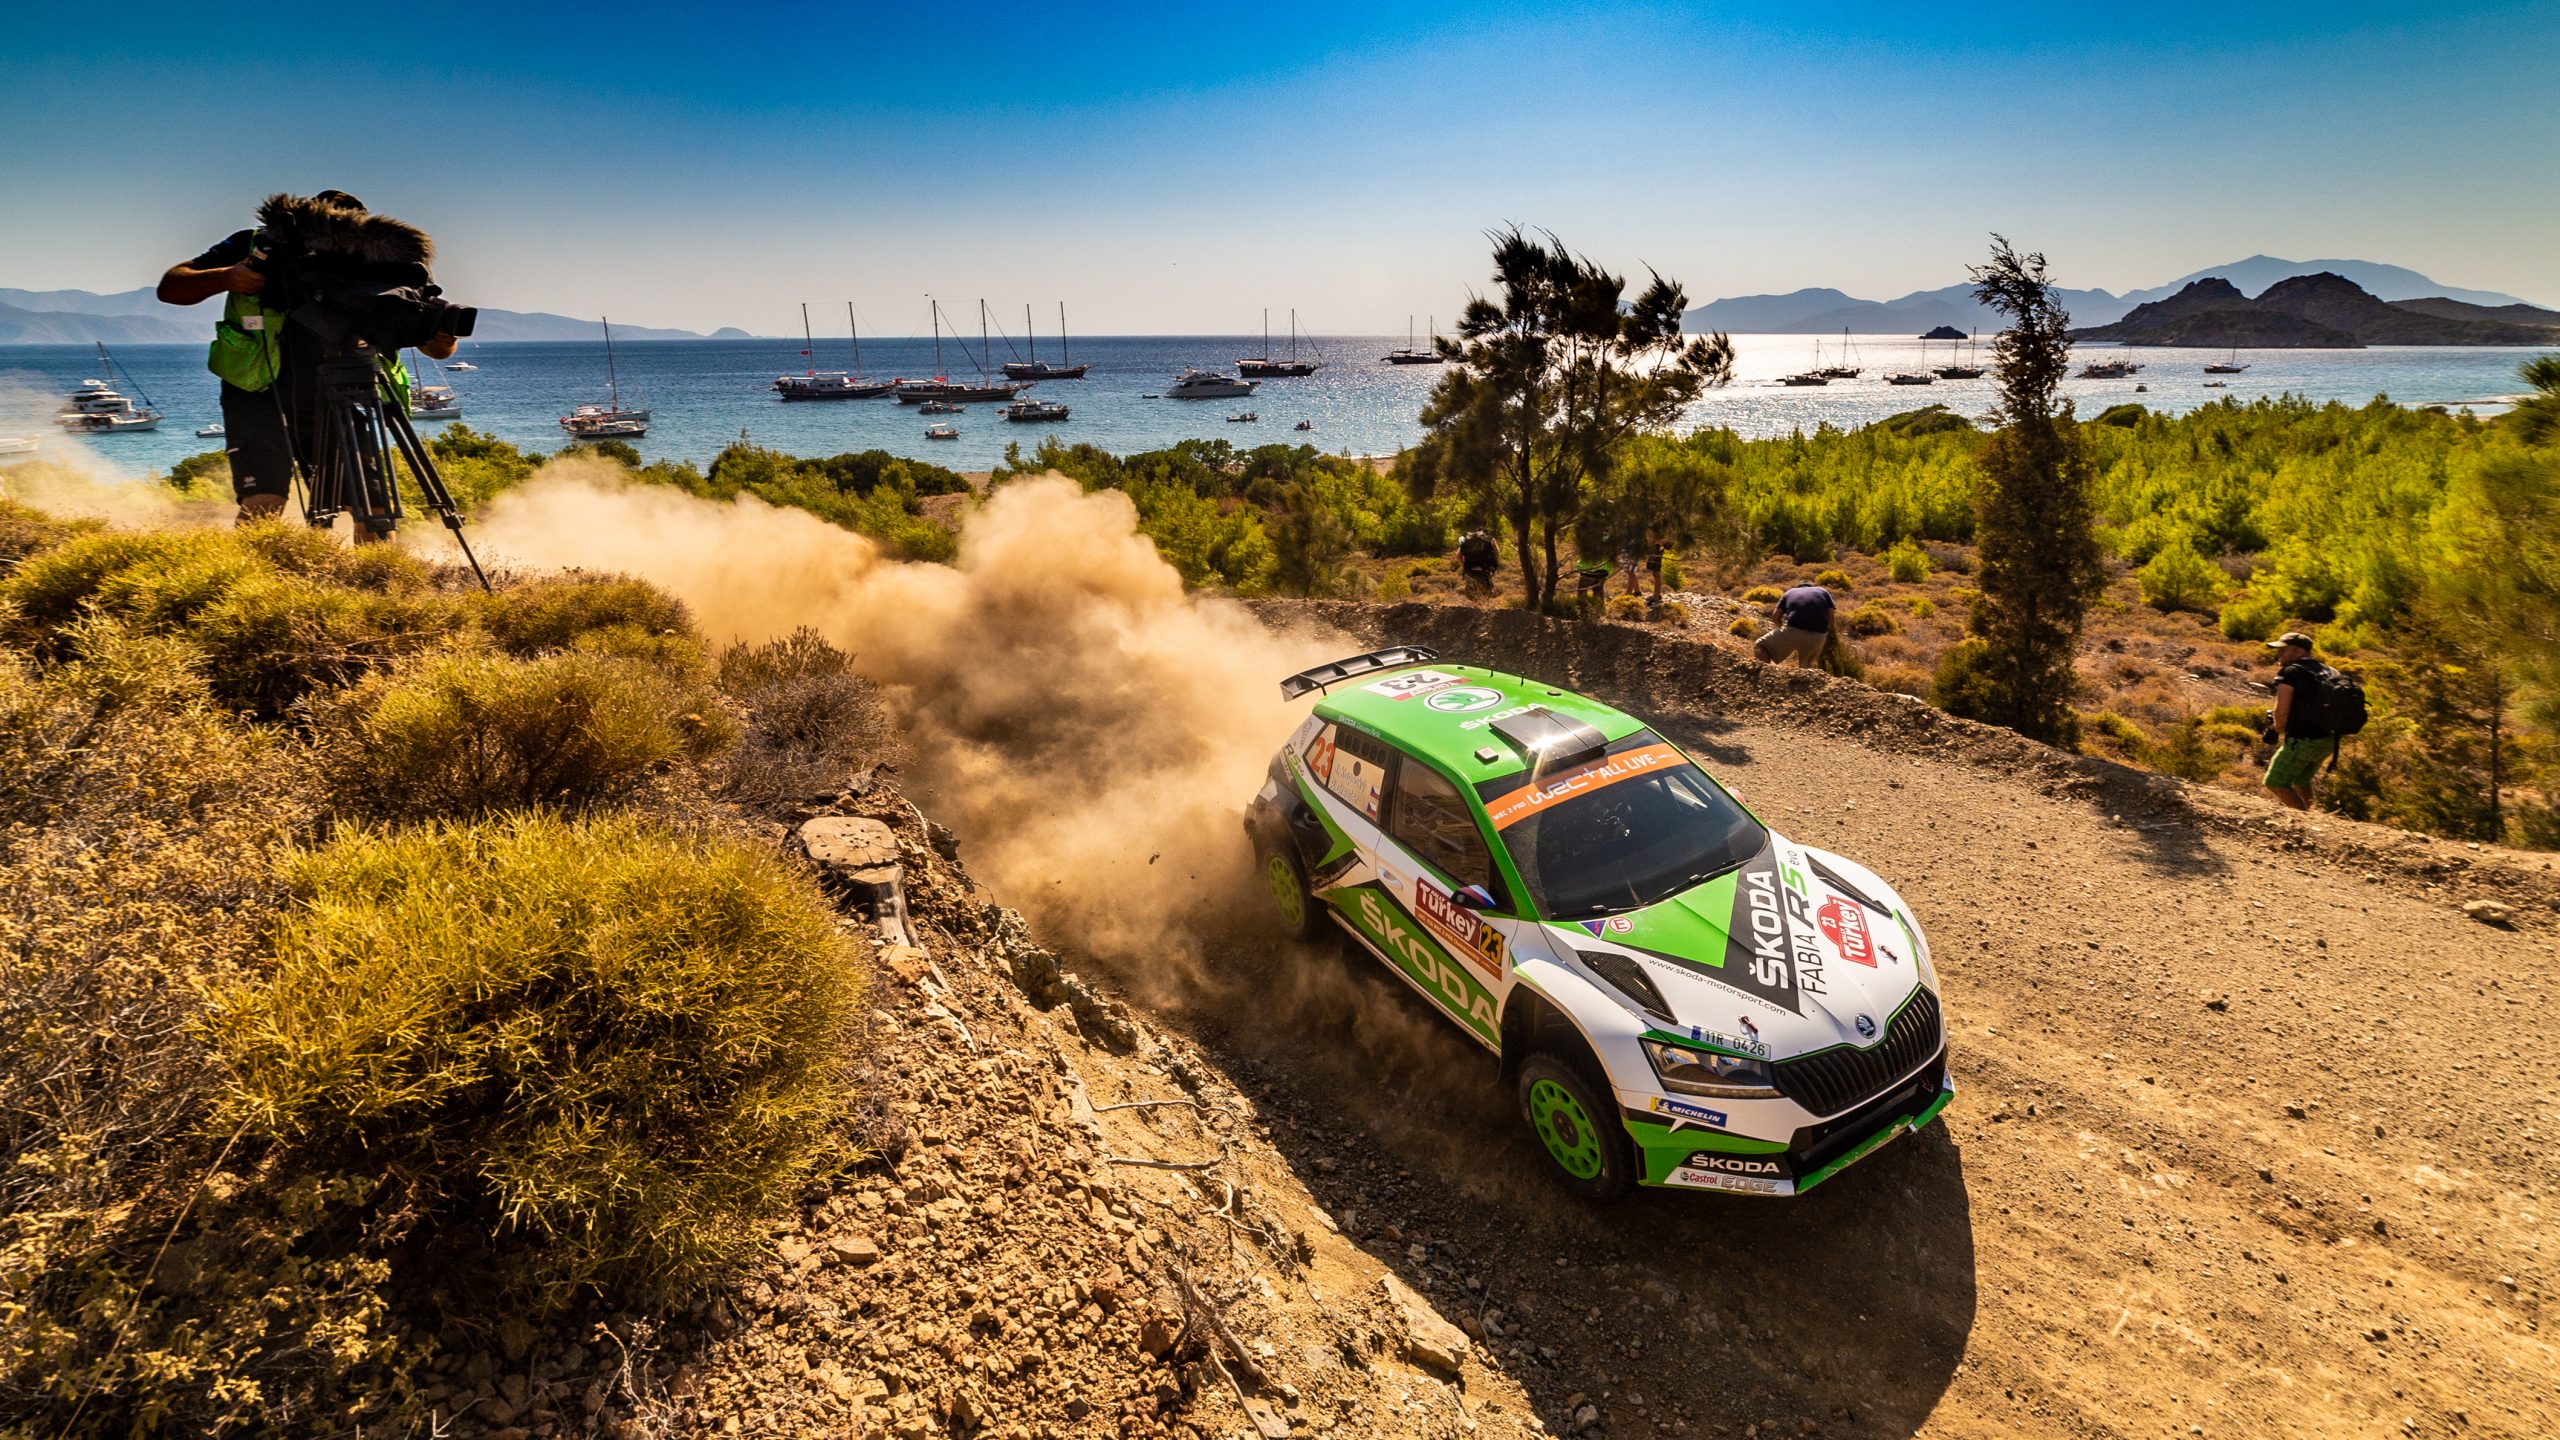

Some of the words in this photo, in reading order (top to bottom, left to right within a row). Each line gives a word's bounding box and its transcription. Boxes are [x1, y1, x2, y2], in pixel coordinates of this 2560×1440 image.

[1380, 673, 1440, 690] 23
[1459, 702, 1549, 731] ŠKODA
[1311, 737, 1335, 778] 23
[1598, 762, 1627, 779] ALL
[1627, 753, 1657, 770] LIVE
[1492, 808, 1508, 821] WRC
[1513, 801, 1527, 812] PRO
[1787, 850, 1799, 866] evo
[1780, 862, 1815, 930] R5
[1420, 882, 1476, 942] Turkey
[1821, 916, 1837, 928] 23
[1747, 871, 1788, 989] ŠKODA
[1838, 900, 1868, 958] Turkey
[1481, 924, 1503, 965] 23
[1360, 890, 1501, 1042] ŠKODA
[1795, 934, 1827, 995] FABIA
[1649, 959, 1786, 1016] www.skoda-motorsport.com
[1705, 1031, 1724, 1045] 11R
[1733, 1038, 1765, 1056] 0426
[1671, 1106, 1720, 1122] MICHELIN
[1692, 1154, 1780, 1173] ŠKODA
[1689, 1173, 1718, 1185] Castrol
[1721, 1175, 1778, 1193] EDGE
